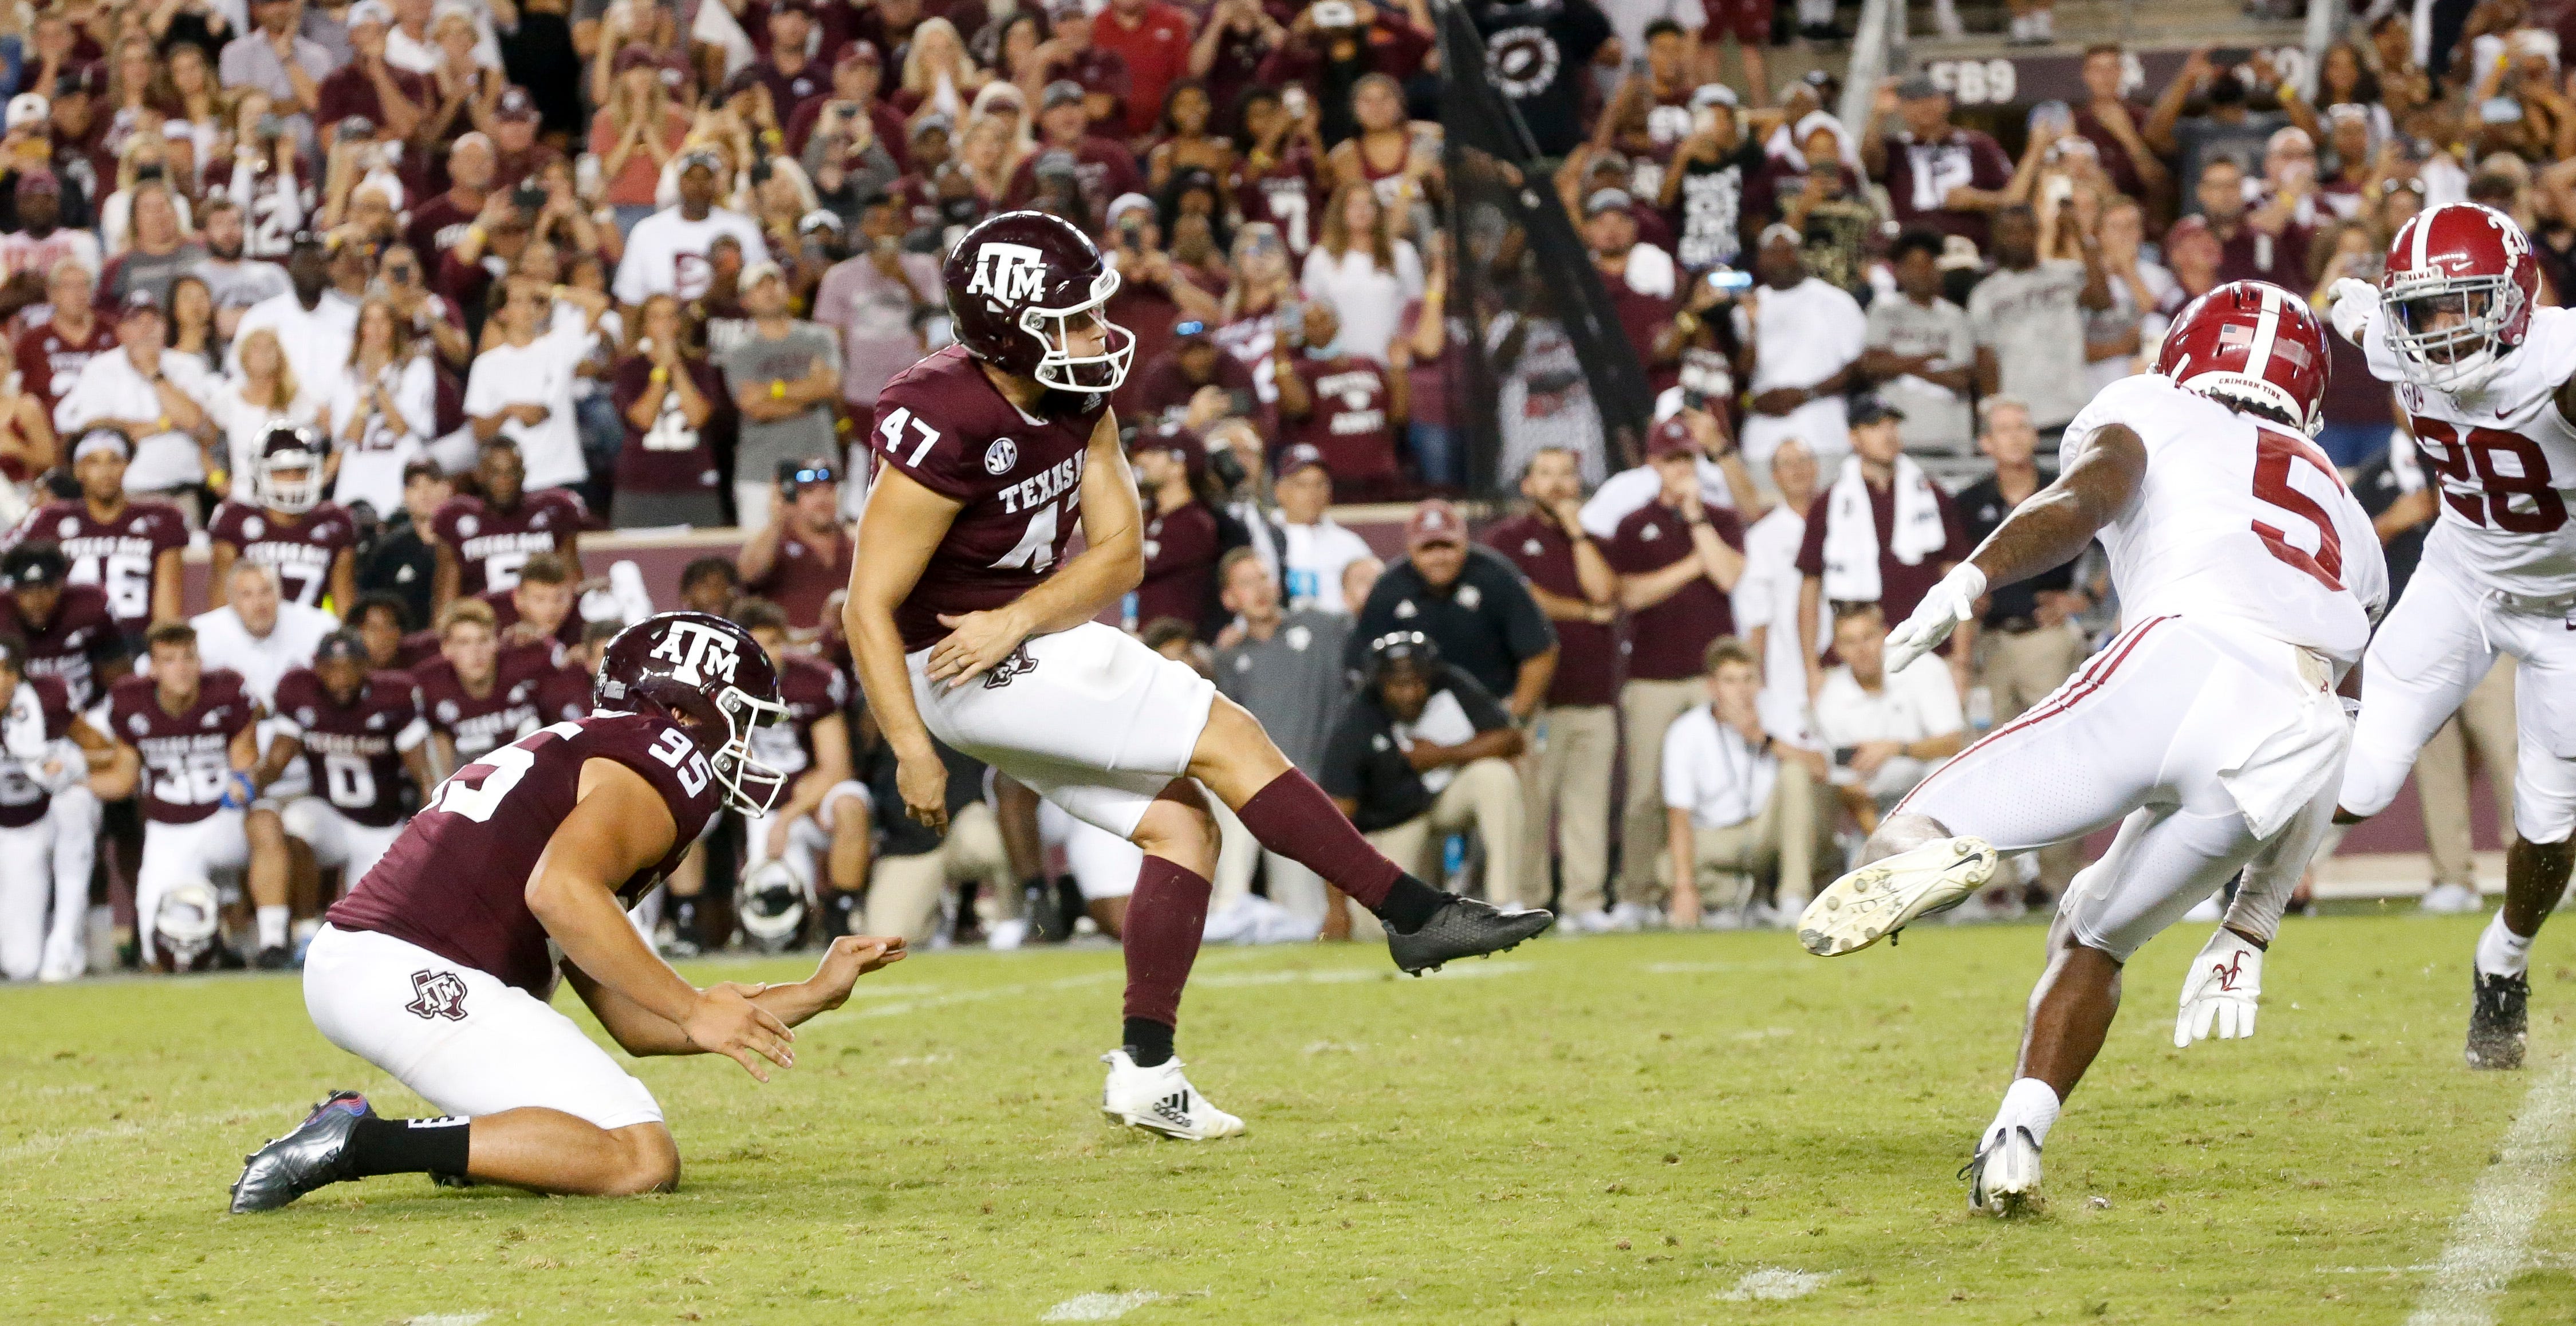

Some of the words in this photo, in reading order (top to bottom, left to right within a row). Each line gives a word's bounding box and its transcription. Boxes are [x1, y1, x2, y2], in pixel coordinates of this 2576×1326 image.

[2219, 378, 2260, 389] CRIMSON
[2263, 385, 2281, 400] TIDE
[880, 407, 940, 468] 47
[986, 439, 1015, 473] SEC
[998, 458, 1074, 514] TEXAS
[2412, 415, 2569, 533] 28
[2251, 426, 2347, 592] 5
[648, 727, 713, 798] 95
[1153, 1101, 1193, 1127] adidas
